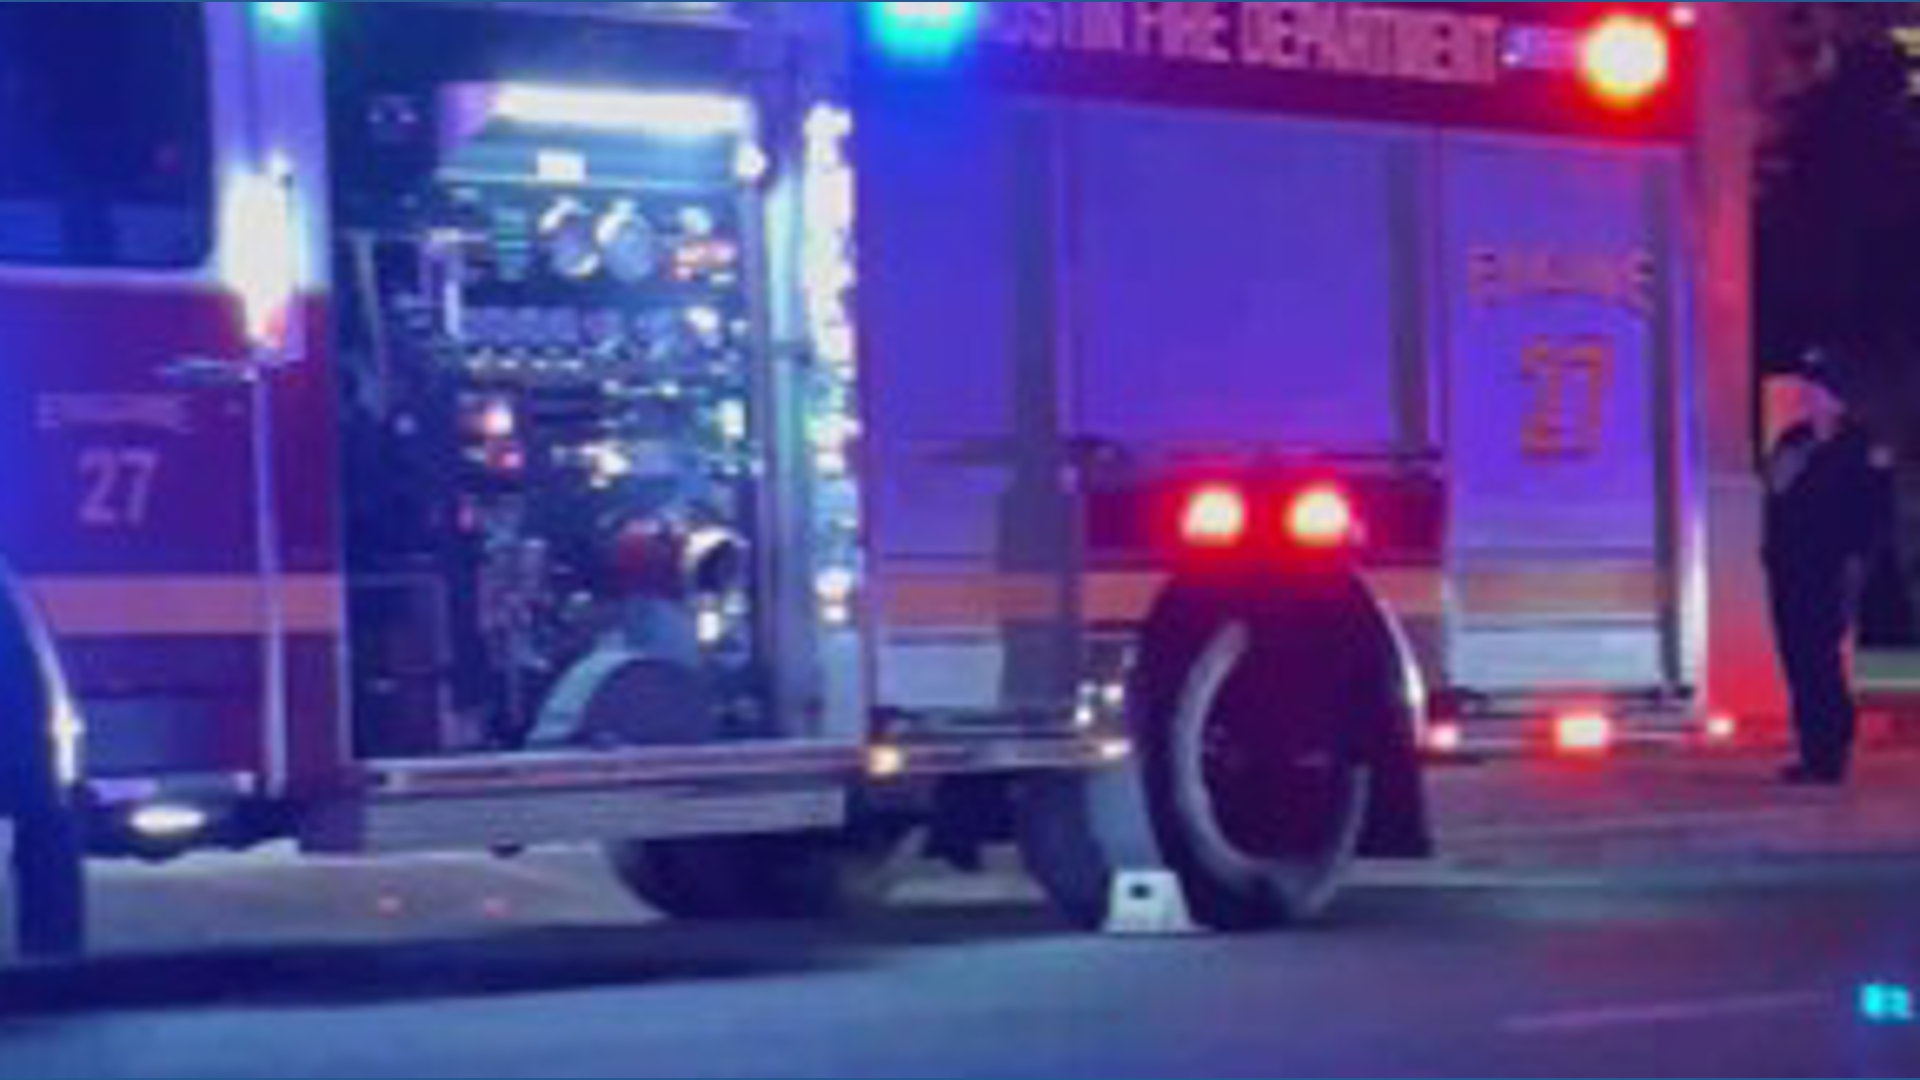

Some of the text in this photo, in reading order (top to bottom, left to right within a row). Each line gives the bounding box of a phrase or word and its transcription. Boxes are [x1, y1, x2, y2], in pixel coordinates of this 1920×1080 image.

[1132, 2, 1231, 62] FIRE
[1240, 2, 1498, 84] DEPARTMENT
[1519, 342, 1610, 458] 27
[78, 446, 158, 525] 27
